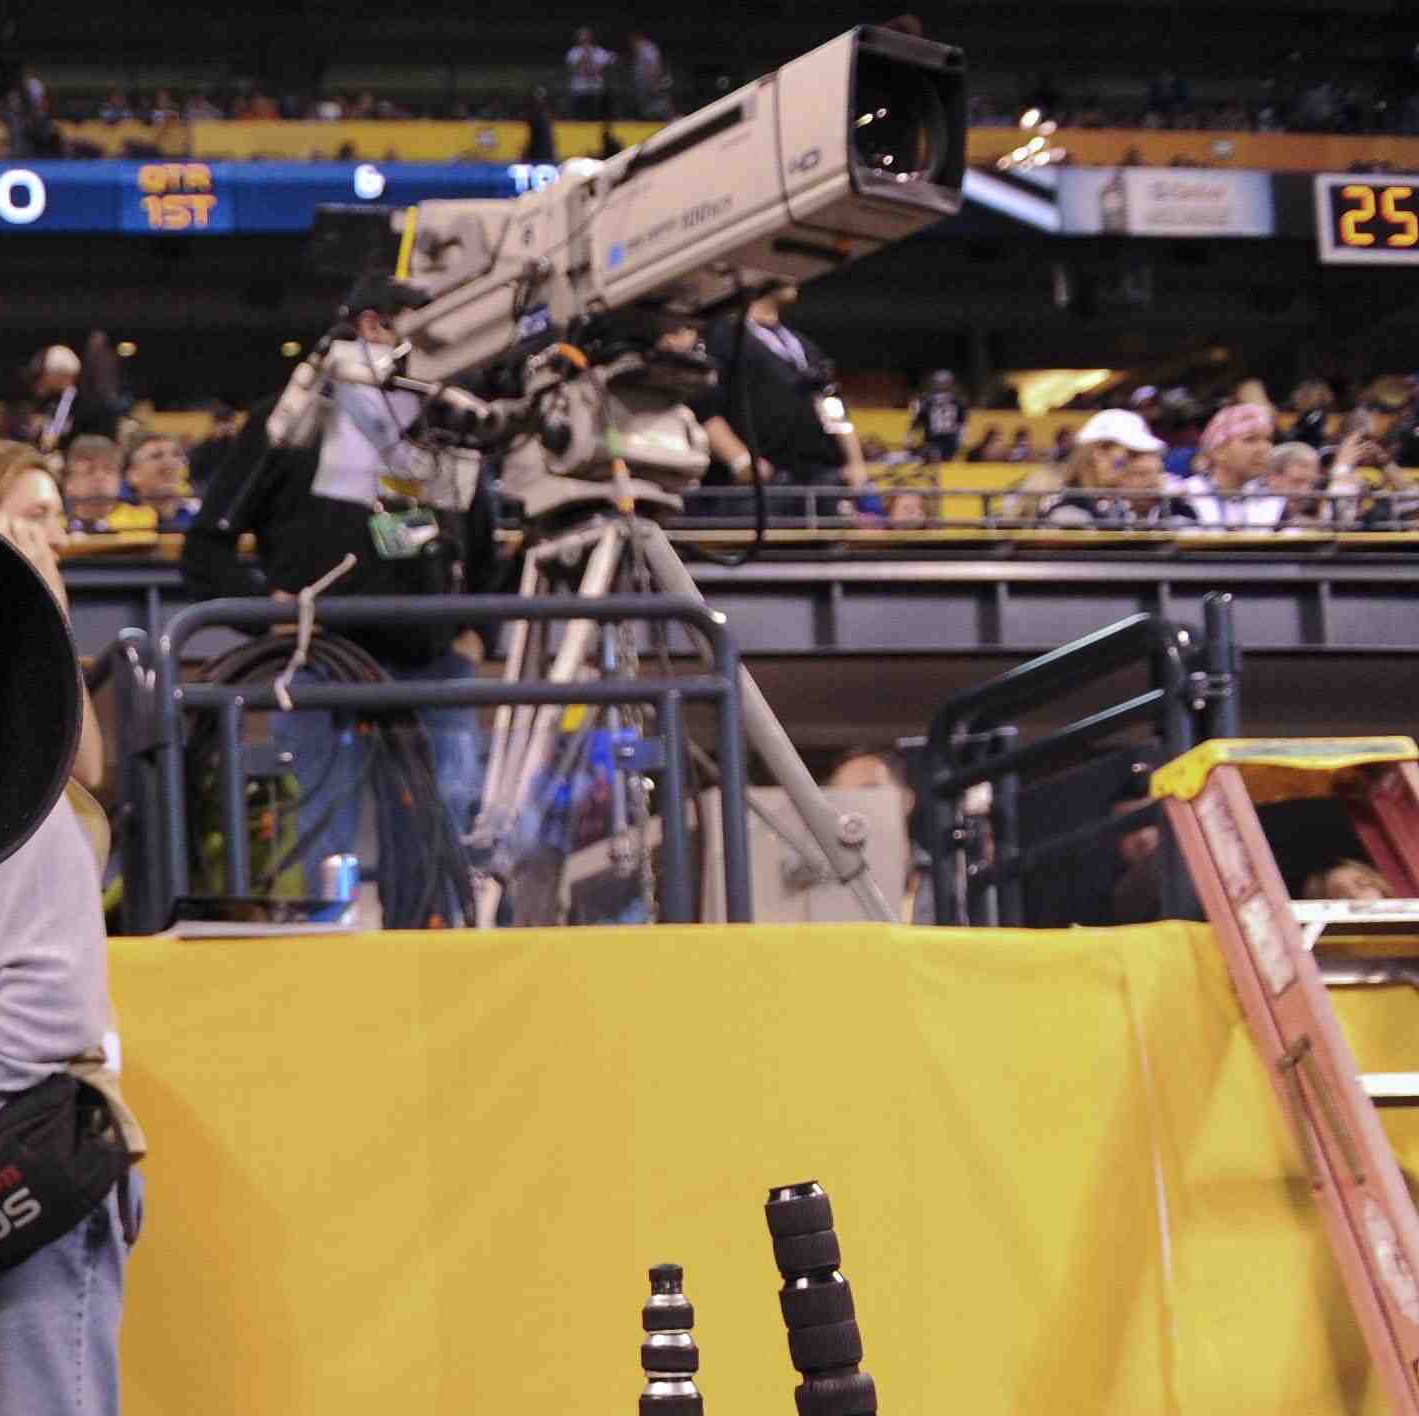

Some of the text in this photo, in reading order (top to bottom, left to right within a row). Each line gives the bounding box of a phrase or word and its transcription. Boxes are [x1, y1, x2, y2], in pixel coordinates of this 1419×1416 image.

[138, 164, 213, 193] QTR
[506, 163, 558, 194] TO
[141, 194, 217, 230] 1ST
[1338, 184, 1418, 246] 25
